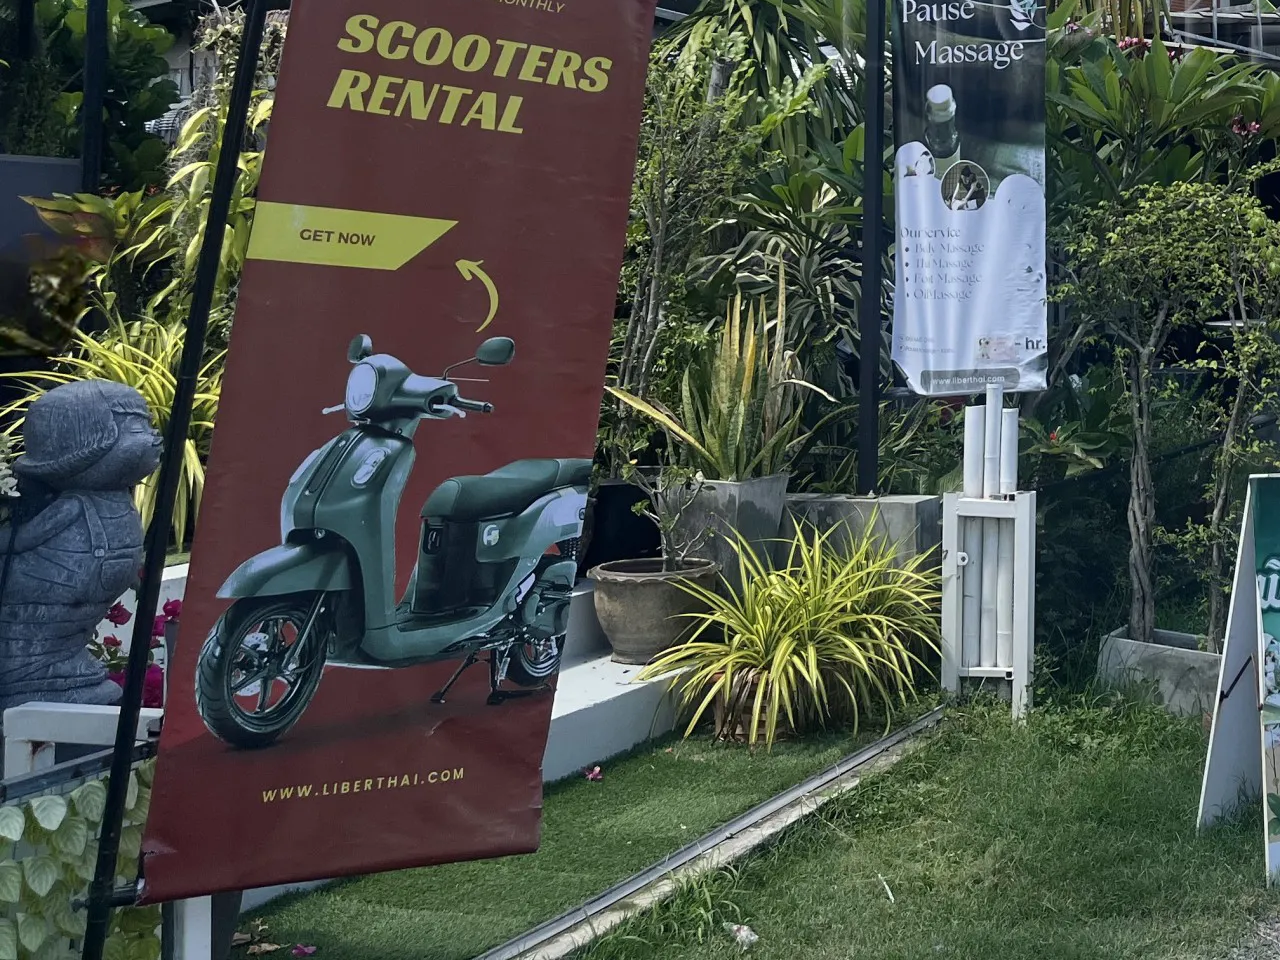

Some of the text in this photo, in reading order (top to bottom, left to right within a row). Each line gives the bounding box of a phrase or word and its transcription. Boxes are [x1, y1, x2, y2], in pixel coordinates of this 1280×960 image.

[336, 13, 613, 93] SCOOTERS
[915, 40, 1024, 70] Massage
[326, 68, 524, 135] RENTAL
[299, 228, 376, 247] GET NOW
[261, 766, 466, 803] WWW.LIBERTHAI.COM
